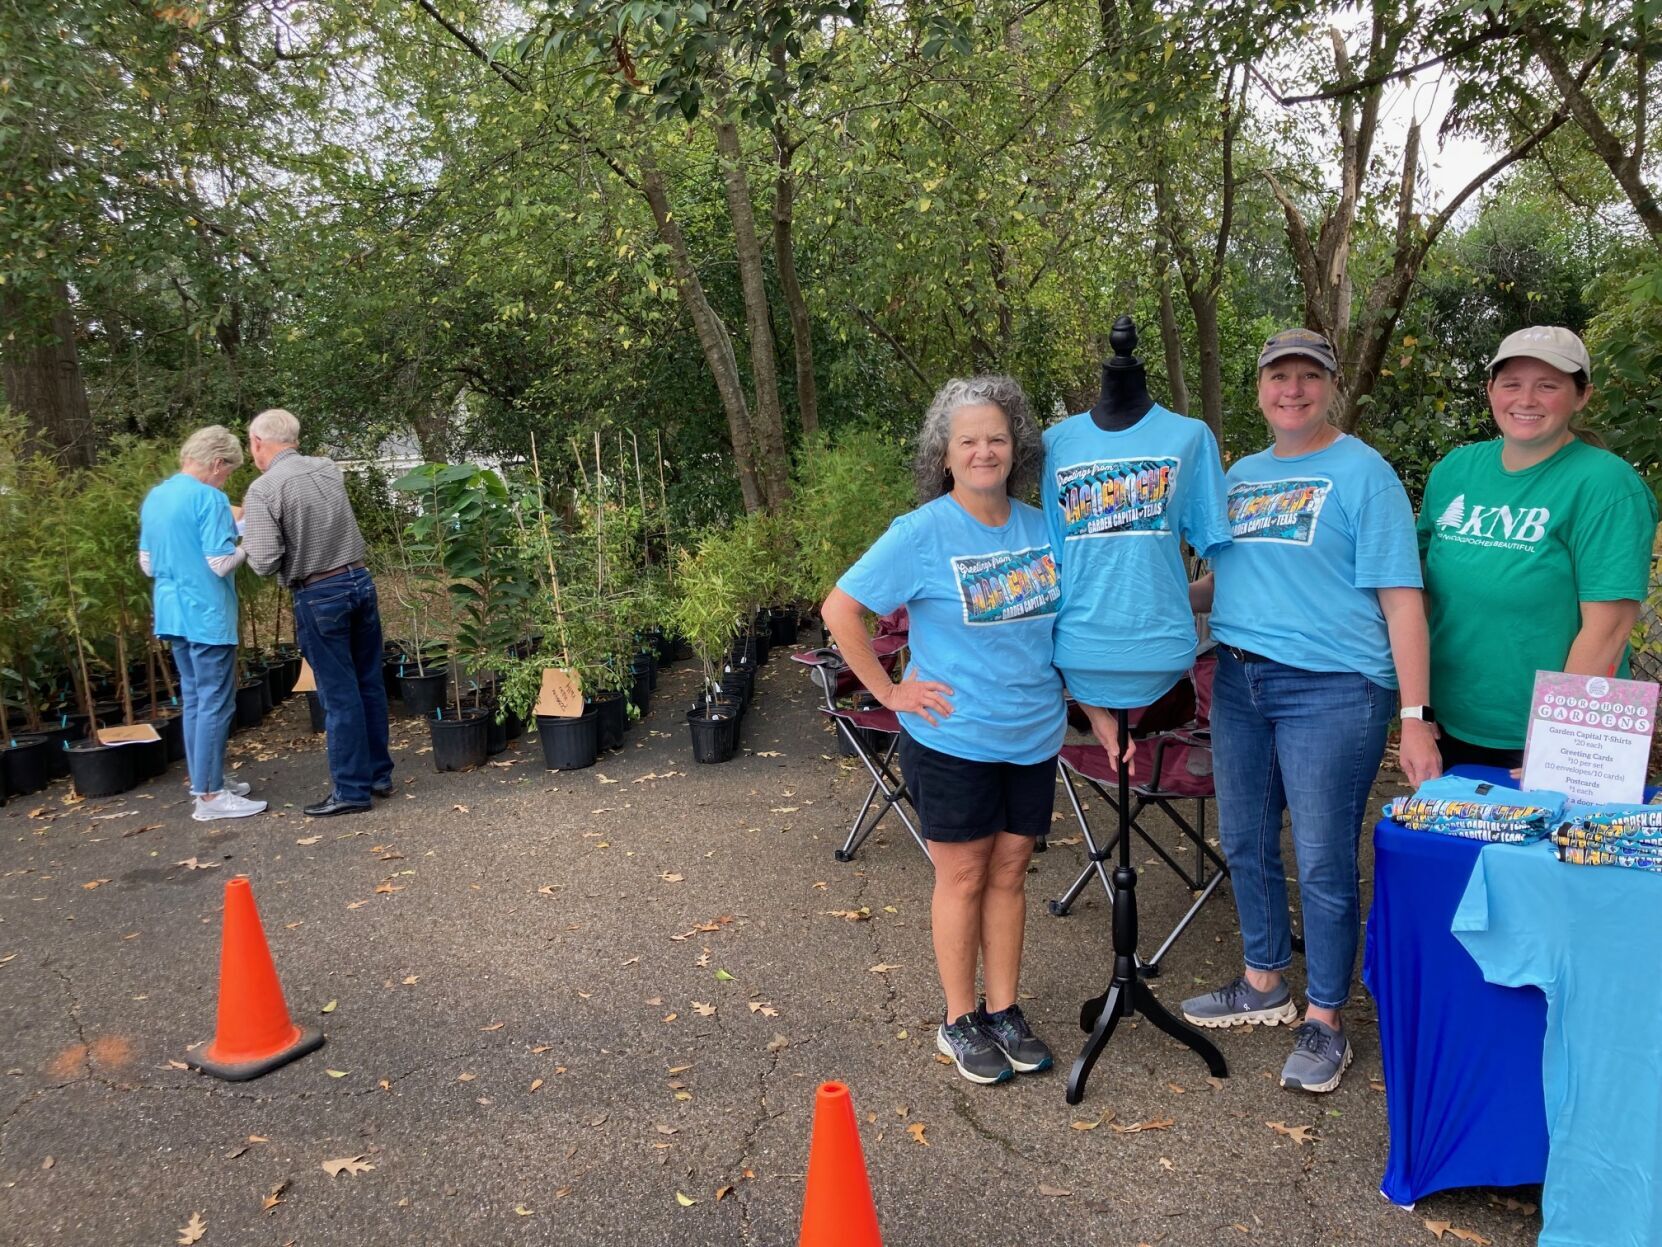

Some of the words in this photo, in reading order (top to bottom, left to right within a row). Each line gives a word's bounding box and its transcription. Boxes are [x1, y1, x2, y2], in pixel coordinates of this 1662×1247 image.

[1092, 463, 1114, 476] from
[1088, 516, 1112, 534] GARDEN
[1112, 508, 1139, 527] CAPITAL
[1143, 502, 1162, 518] TEXAS
[1247, 515, 1272, 533] CAPITAL
[1277, 512, 1298, 527] TEXAS
[1456, 505, 1550, 542] KNB
[957, 558, 992, 579] Greetings
[991, 556, 1012, 569] from
[1002, 603, 1025, 620] GARDEN
[1024, 594, 1046, 612] CAPITAL
[1545, 695, 1587, 708] TOUR
[1602, 703, 1647, 716] HOME
[1539, 706, 1648, 731] GARDENS
[1549, 727, 1575, 737] Garden
[1576, 730, 1602, 741] Capital
[1603, 735, 1632, 745] T-Shirts
[1586, 741, 1603, 749] each
[1560, 748, 1591, 760] Greeting
[1592, 753, 1614, 762] Cards
[1580, 760, 1591, 768] per
[1565, 777, 1600, 789] Postcards
[1576, 787, 1594, 796] each
